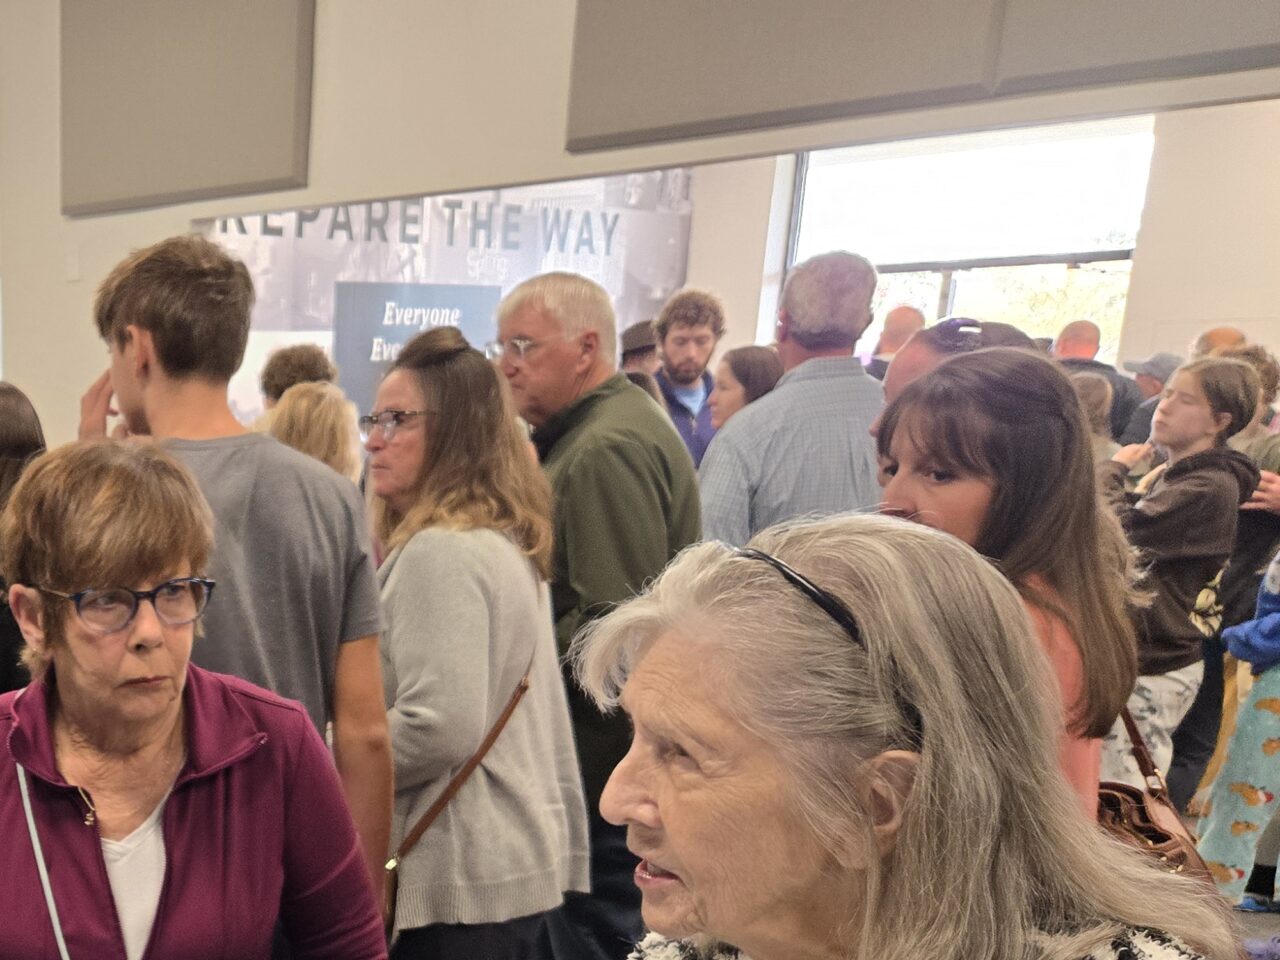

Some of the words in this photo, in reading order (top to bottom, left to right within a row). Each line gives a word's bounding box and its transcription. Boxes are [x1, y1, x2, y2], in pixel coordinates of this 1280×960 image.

[442, 200, 521, 250] THE
[541, 206, 620, 256] WAY
[382, 302, 463, 329] Everyone
